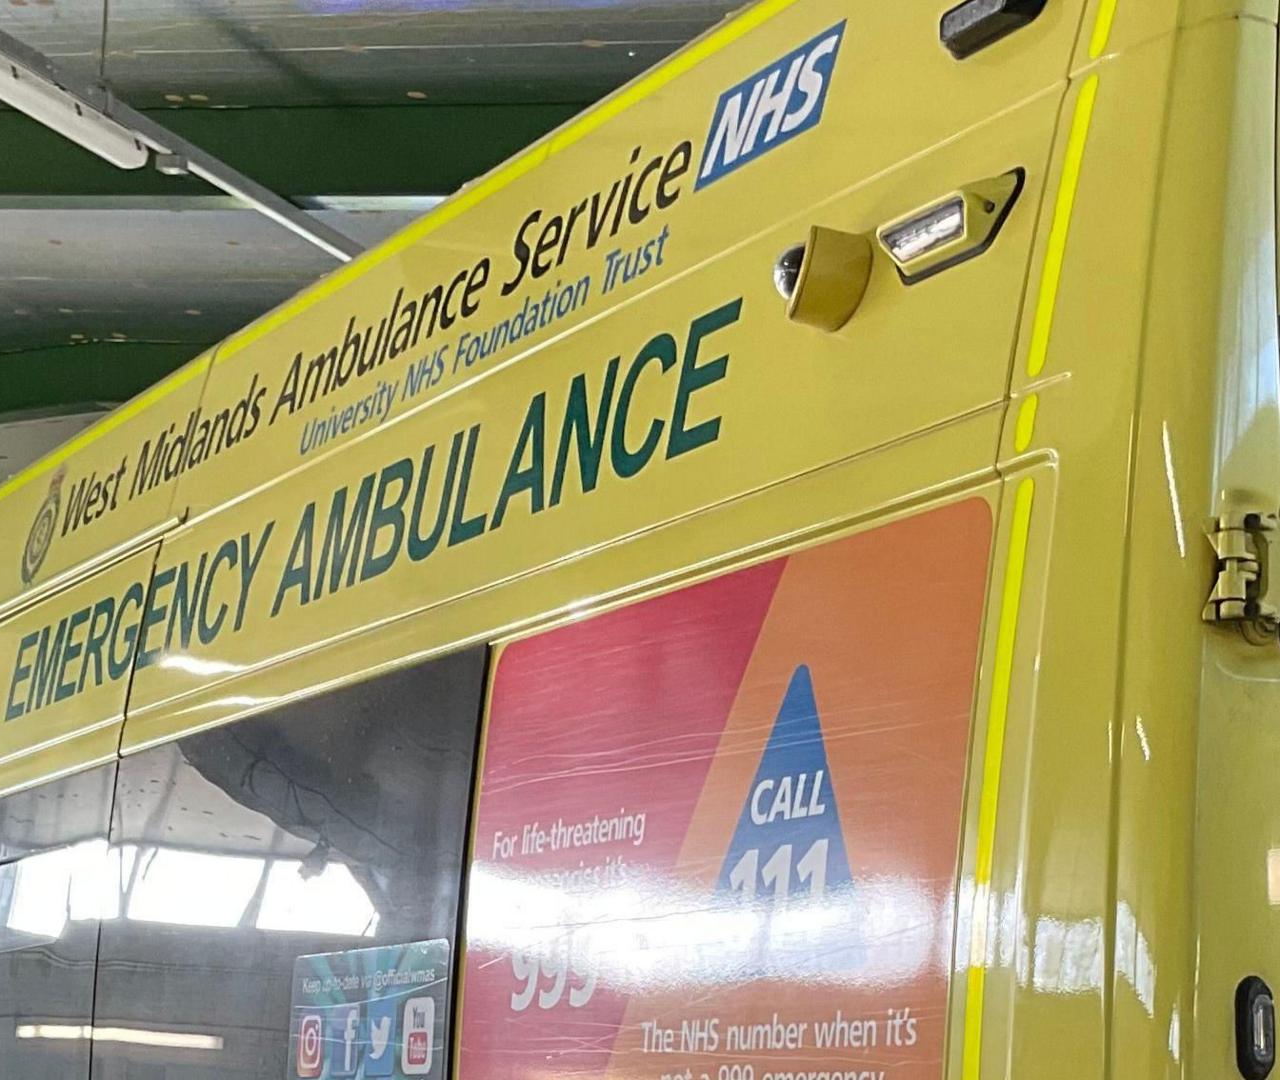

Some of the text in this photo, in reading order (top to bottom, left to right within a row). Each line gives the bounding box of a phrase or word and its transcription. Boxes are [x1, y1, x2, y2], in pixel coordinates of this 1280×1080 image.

[700, 34, 840, 179] NHS
[61, 140, 692, 538] West Midlands Ambulance Service
[300, 225, 670, 456] University NHS Foundation Trust
[6, 297, 743, 722] EMERGENCY AMBULANCE
[493, 807, 647, 860] For life-threatening
[751, 770, 826, 826] CALL
[412, 1006, 426, 1030] You
[641, 1006, 918, 1053] The NHS number when it's
